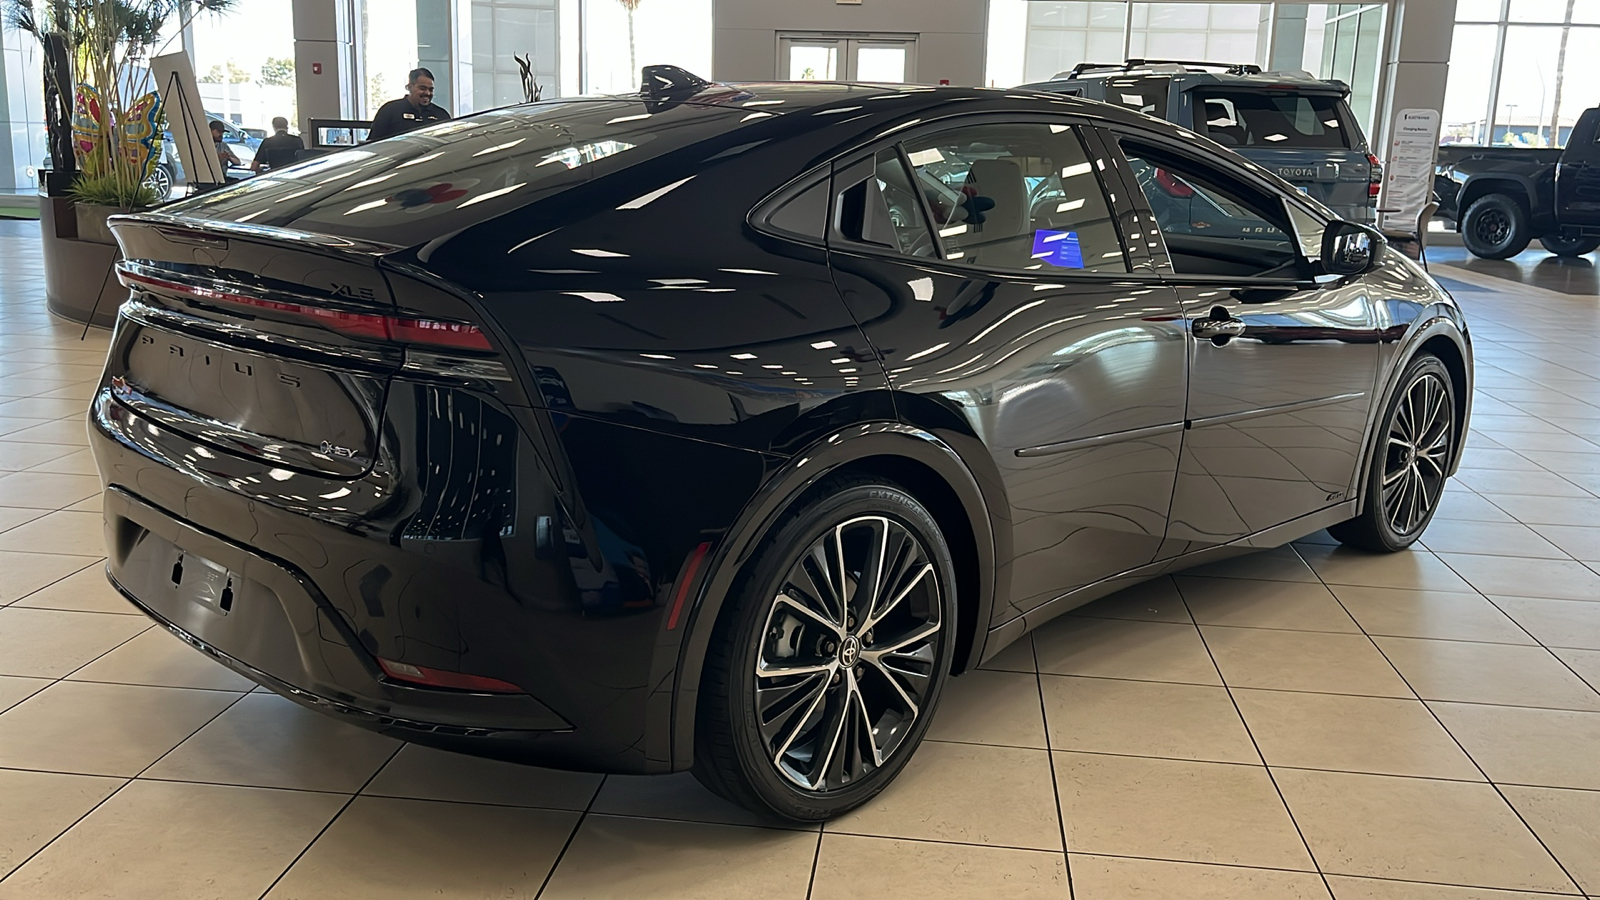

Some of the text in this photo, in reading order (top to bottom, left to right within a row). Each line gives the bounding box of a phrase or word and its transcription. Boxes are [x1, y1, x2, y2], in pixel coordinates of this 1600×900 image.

[1278, 168, 1313, 176] TOYOTA
[331, 282, 375, 300] XLE
[142, 335, 301, 388] PRIUS
[869, 490, 921, 514] EXTENSA
